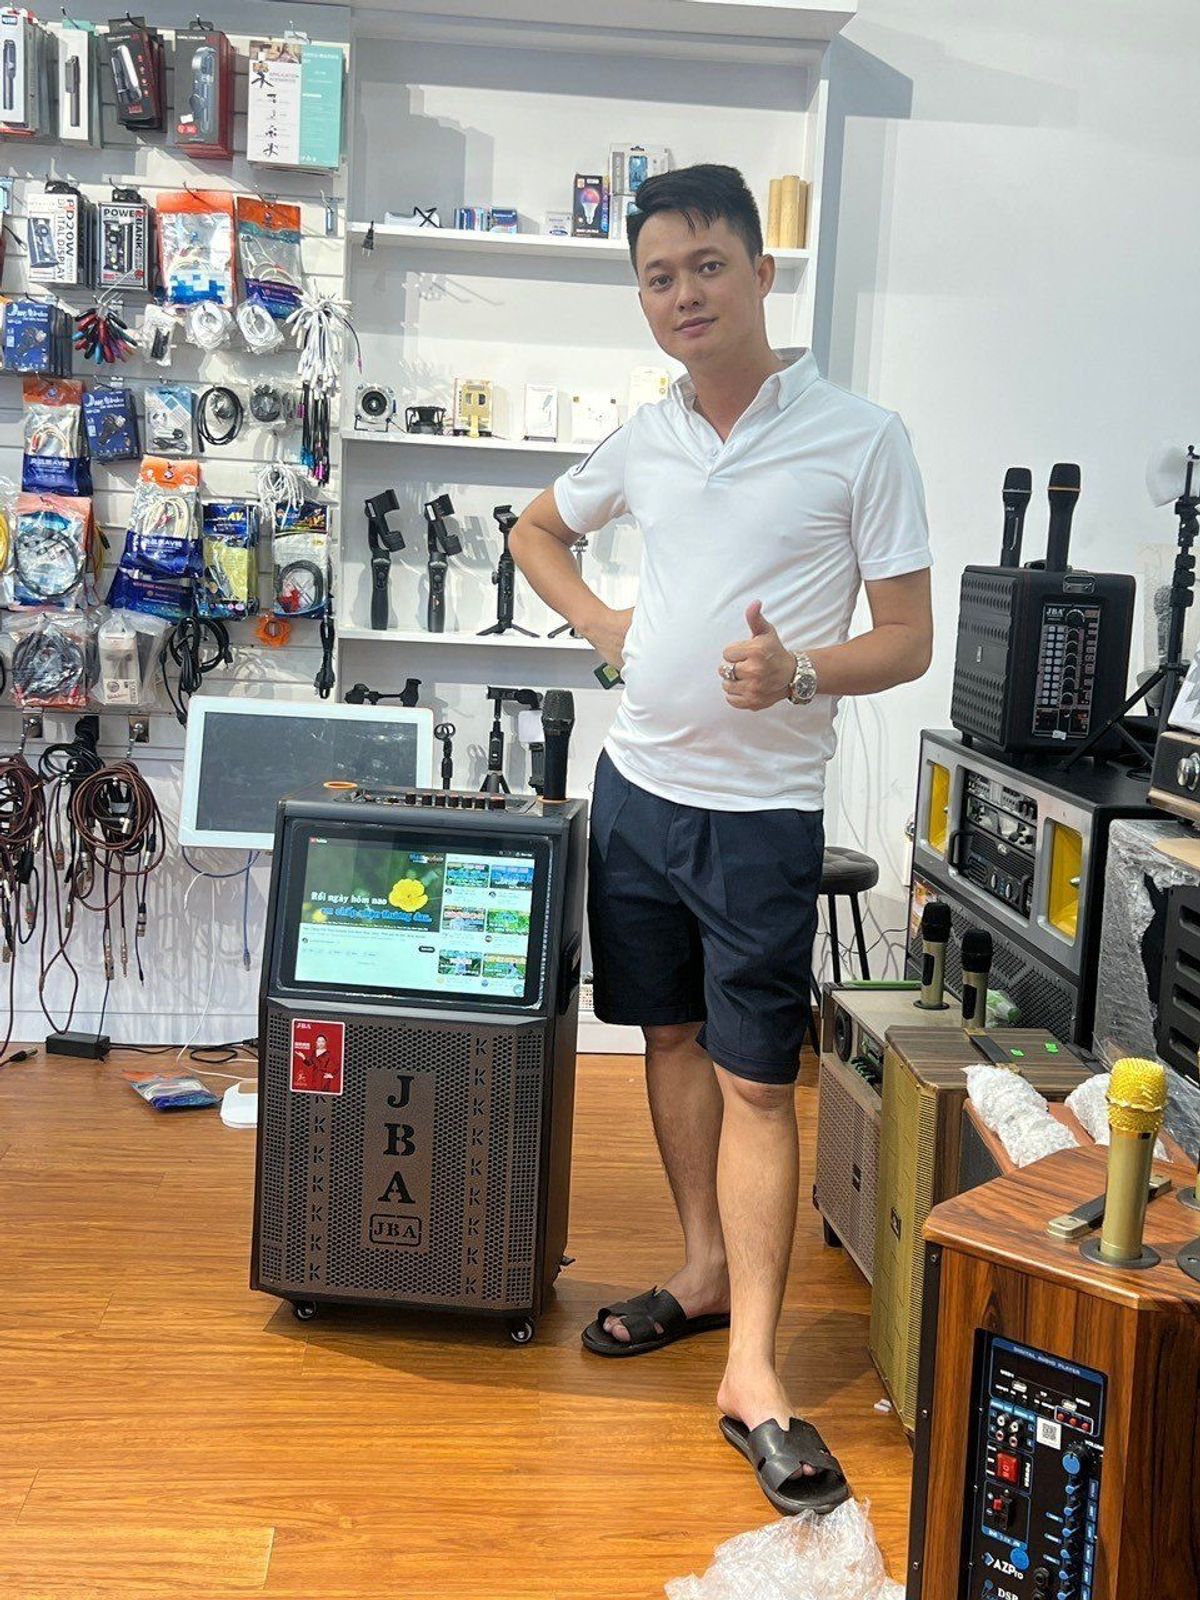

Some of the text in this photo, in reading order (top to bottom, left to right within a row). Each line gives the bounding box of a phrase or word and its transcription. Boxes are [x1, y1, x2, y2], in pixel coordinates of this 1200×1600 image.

[57, 199, 65, 281] DIITAL DISPLAY
[373, 1222, 417, 1239] JBA
[993, 1559, 1024, 1580] AZPro
